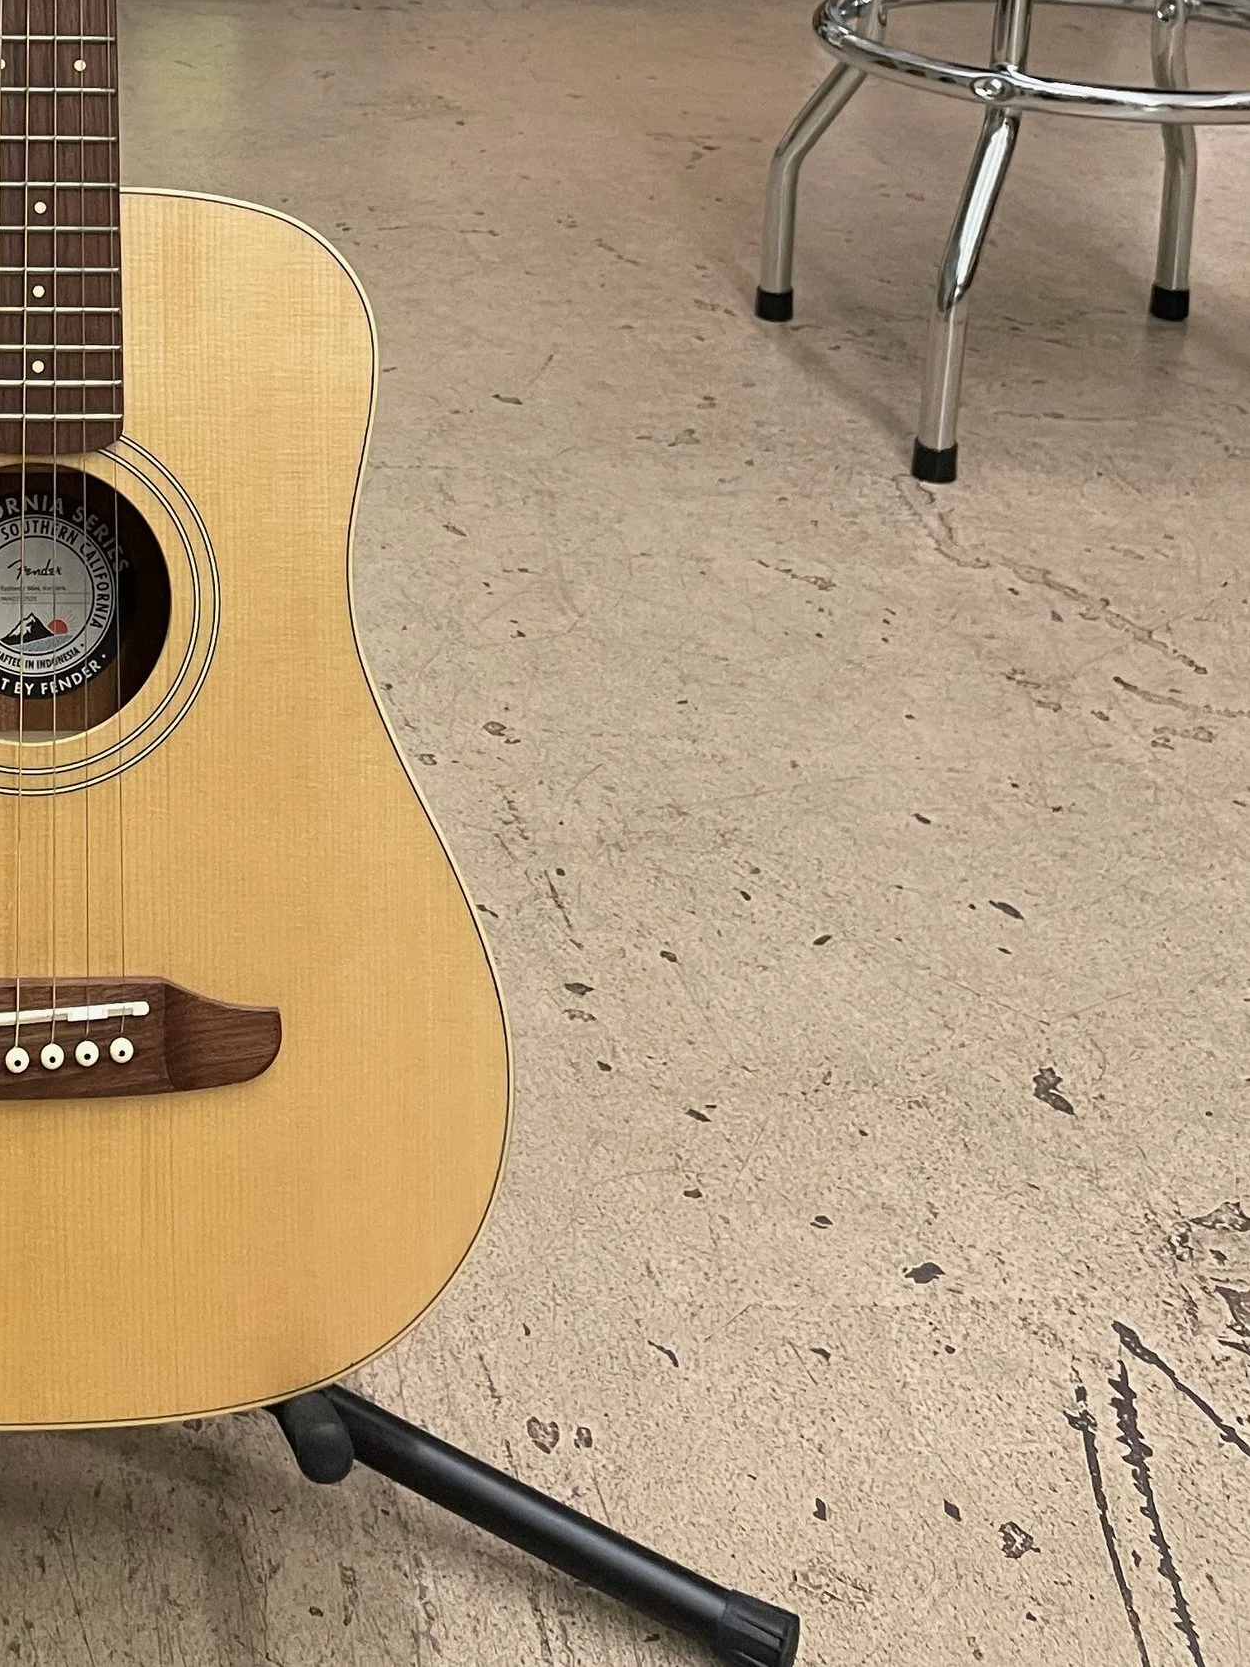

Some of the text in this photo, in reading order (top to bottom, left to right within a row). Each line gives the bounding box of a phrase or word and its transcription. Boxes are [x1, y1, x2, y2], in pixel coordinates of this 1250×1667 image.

[72, 506, 129, 573] SERIES
[1, 520, 78, 545] SOUTHERN
[80, 542, 110, 628] CALIFORNIA
[7, 559, 62, 580] Fender
[14, 681, 34, 695] BY
[41, 659, 101, 695] FENDER
